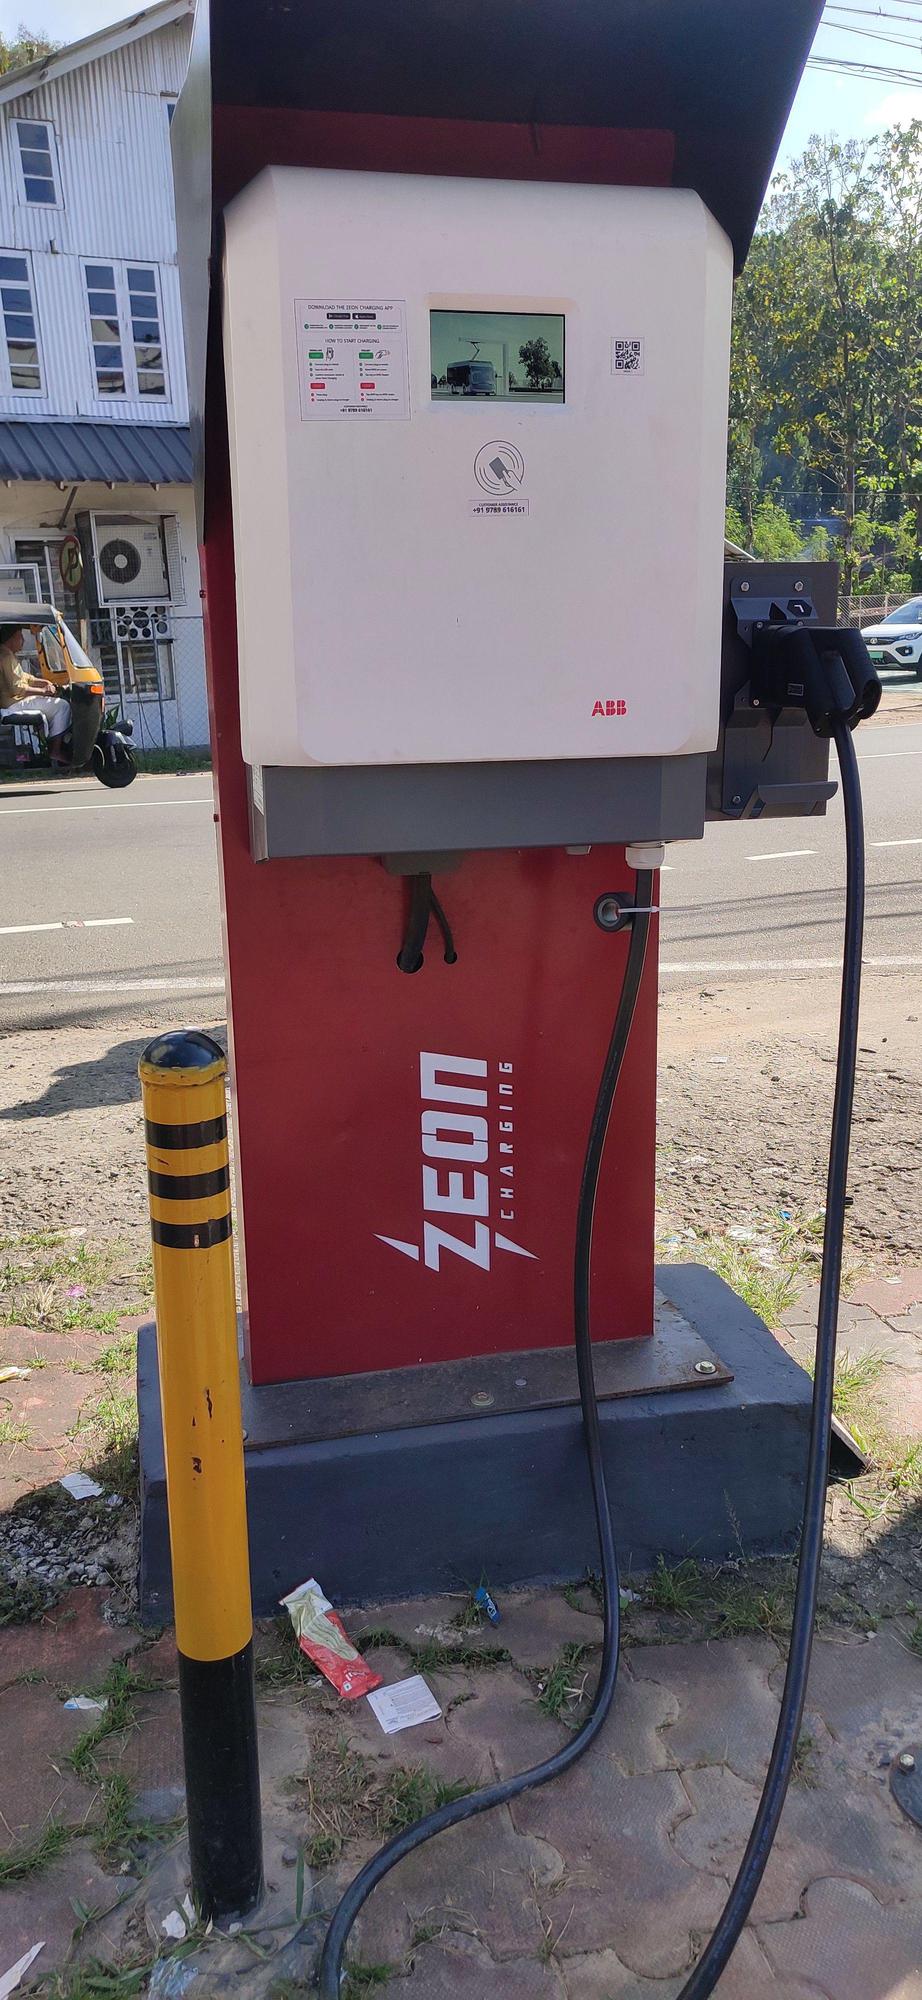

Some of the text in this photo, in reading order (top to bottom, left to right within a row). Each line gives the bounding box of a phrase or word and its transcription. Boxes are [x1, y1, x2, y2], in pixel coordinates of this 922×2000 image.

[591, 700, 627, 717] ABB
[420, 1051, 490, 1272] ZEON
[499, 1061, 514, 1220] CHARGING
